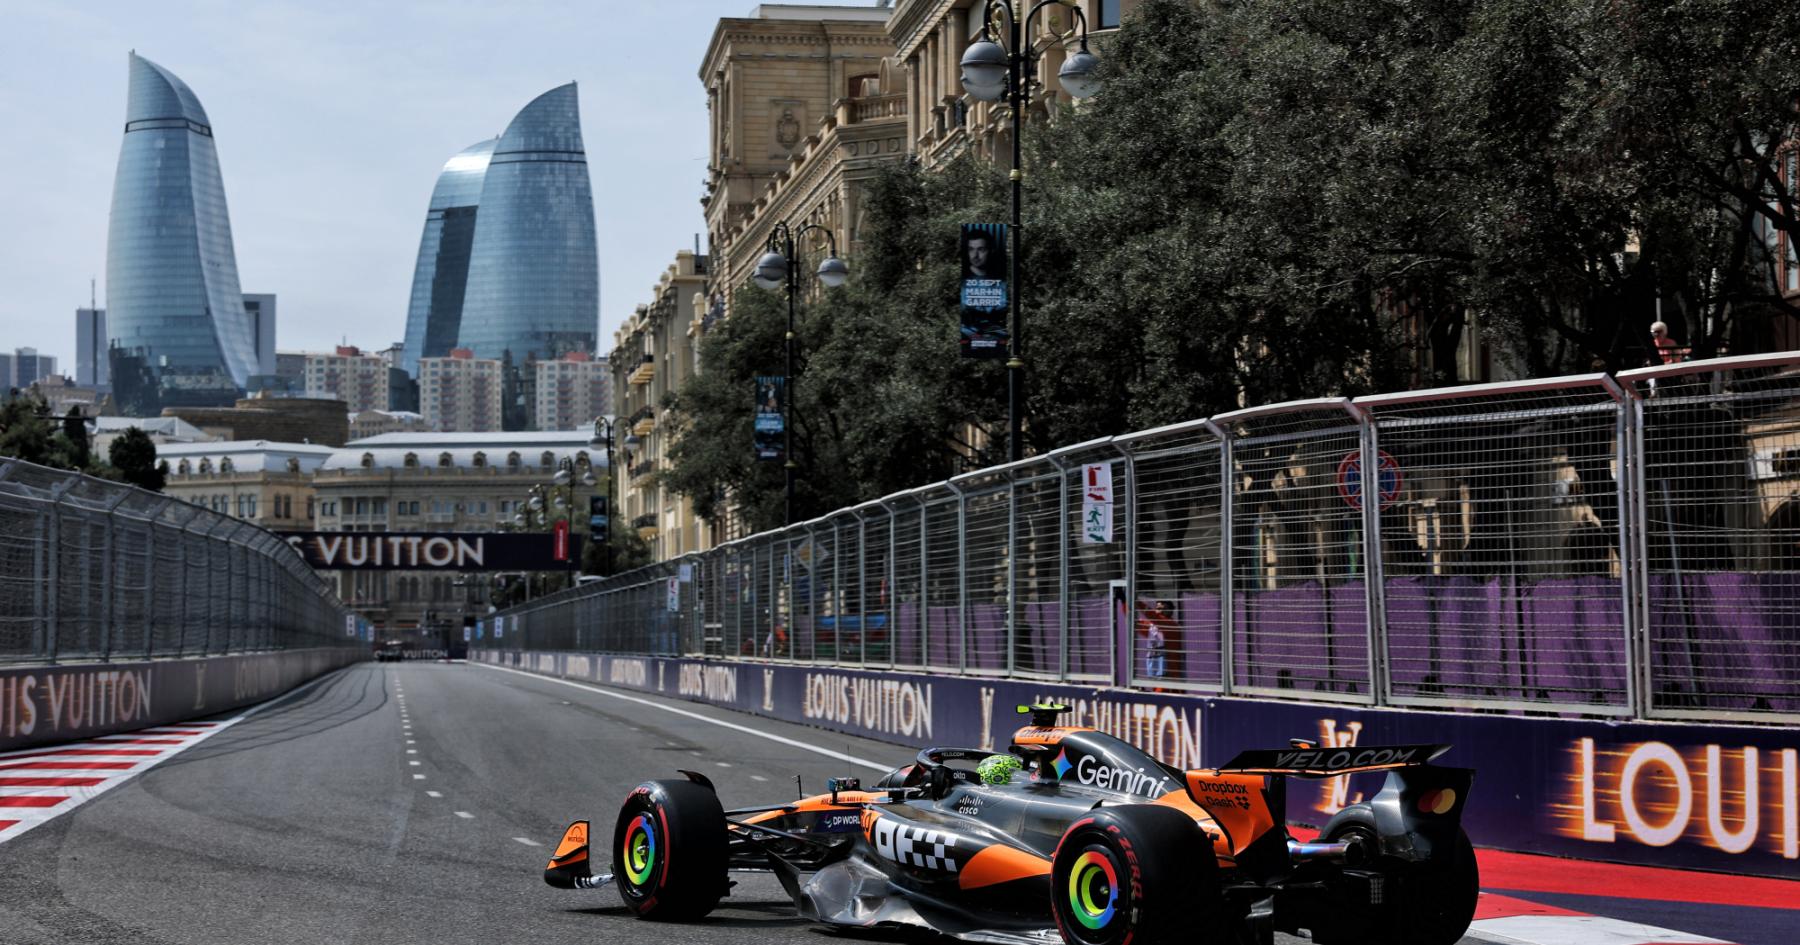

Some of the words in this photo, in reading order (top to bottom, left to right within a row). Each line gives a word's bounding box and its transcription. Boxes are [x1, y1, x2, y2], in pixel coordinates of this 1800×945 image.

[317, 535, 484, 566] VUITTON
[0, 675, 37, 738] IS
[47, 668, 152, 733] VUITTON
[805, 672, 849, 725] LOUIS
[852, 677, 932, 740] VUITTON
[1274, 748, 1417, 769] VELO.COM
[1076, 754, 1169, 800] Gemini
[1198, 780, 1248, 795] Dropbox
[1205, 796, 1237, 809] Dash
[832, 816, 842, 826] DP
[1118, 836, 1143, 899] ZERO
